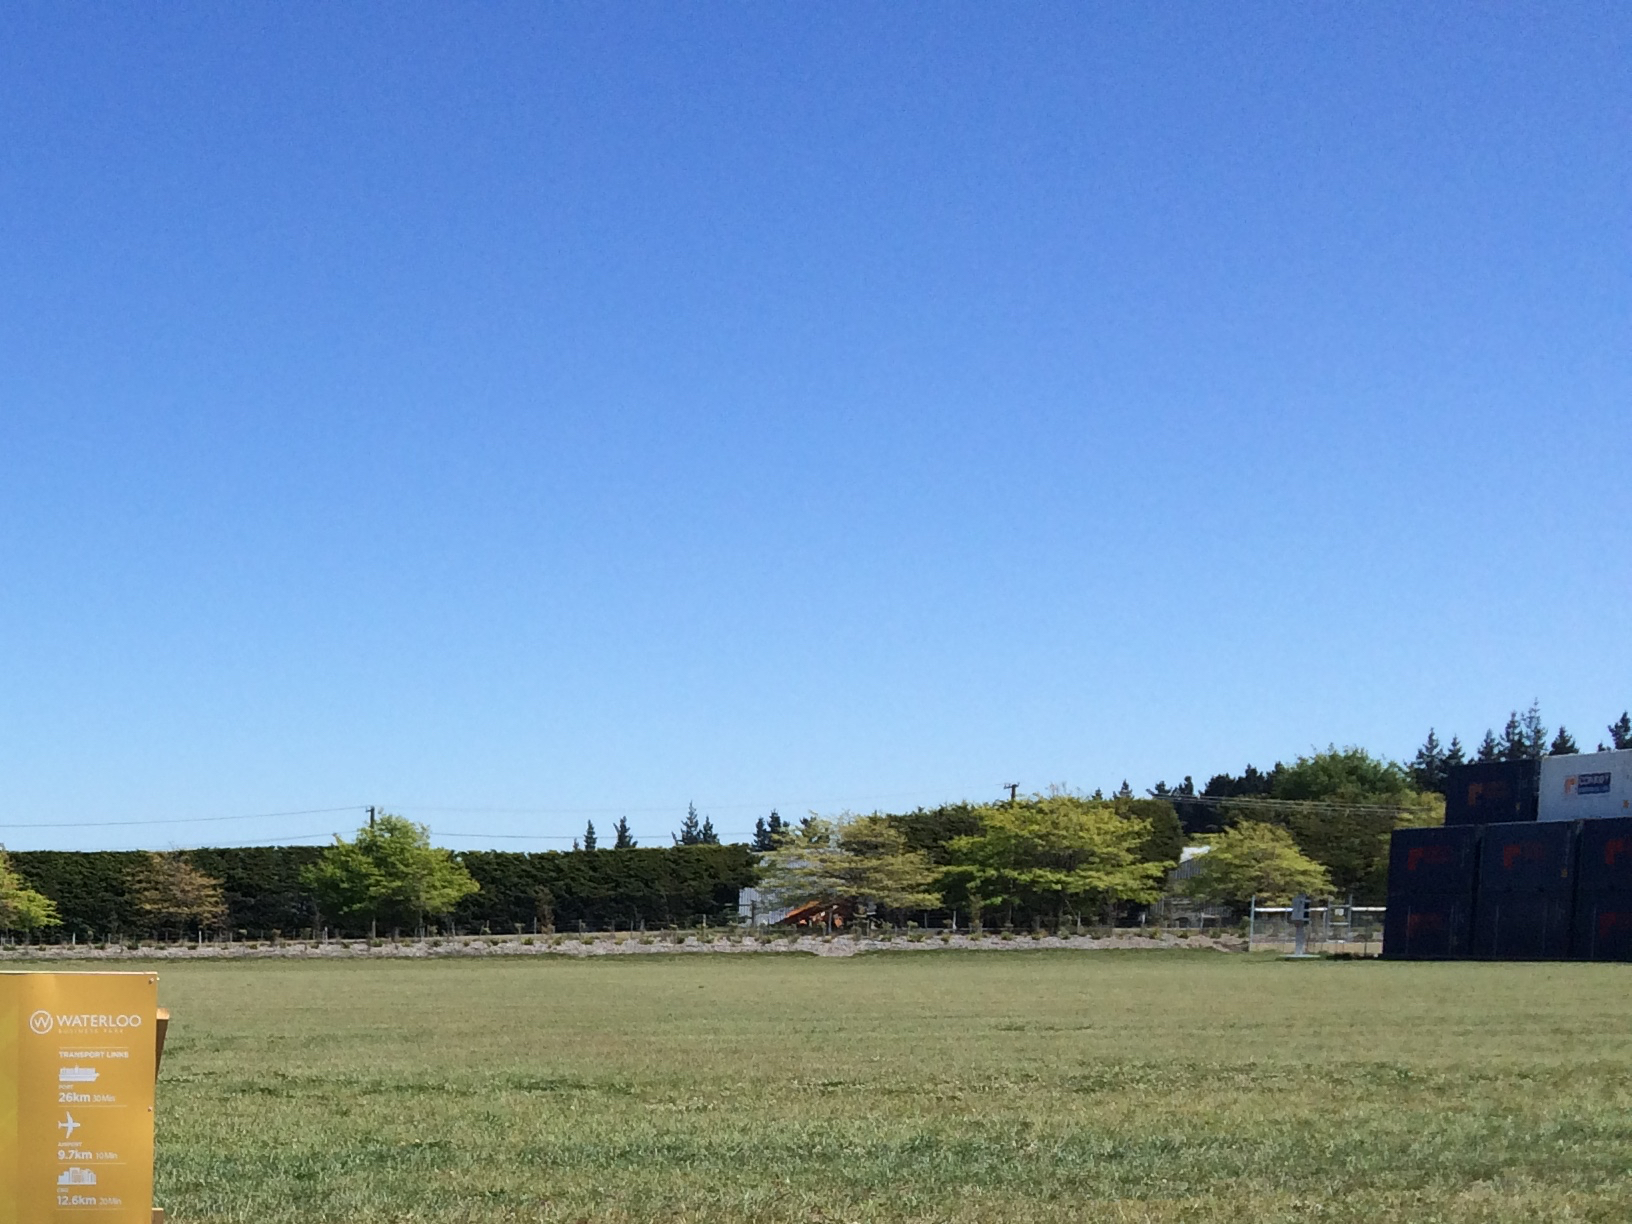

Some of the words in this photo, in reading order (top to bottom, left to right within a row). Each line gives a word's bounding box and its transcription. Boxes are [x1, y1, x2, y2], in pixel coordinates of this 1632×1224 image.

[56, 1014, 142, 1027] WATERLOO
[58, 1051, 104, 1059] TRANSPORT
[106, 1051, 129, 1059] LINKS
[58, 1092, 91, 1103] 26km
[57, 1149, 93, 1160] 9.7km
[56, 1195, 97, 1205] 12.6km
